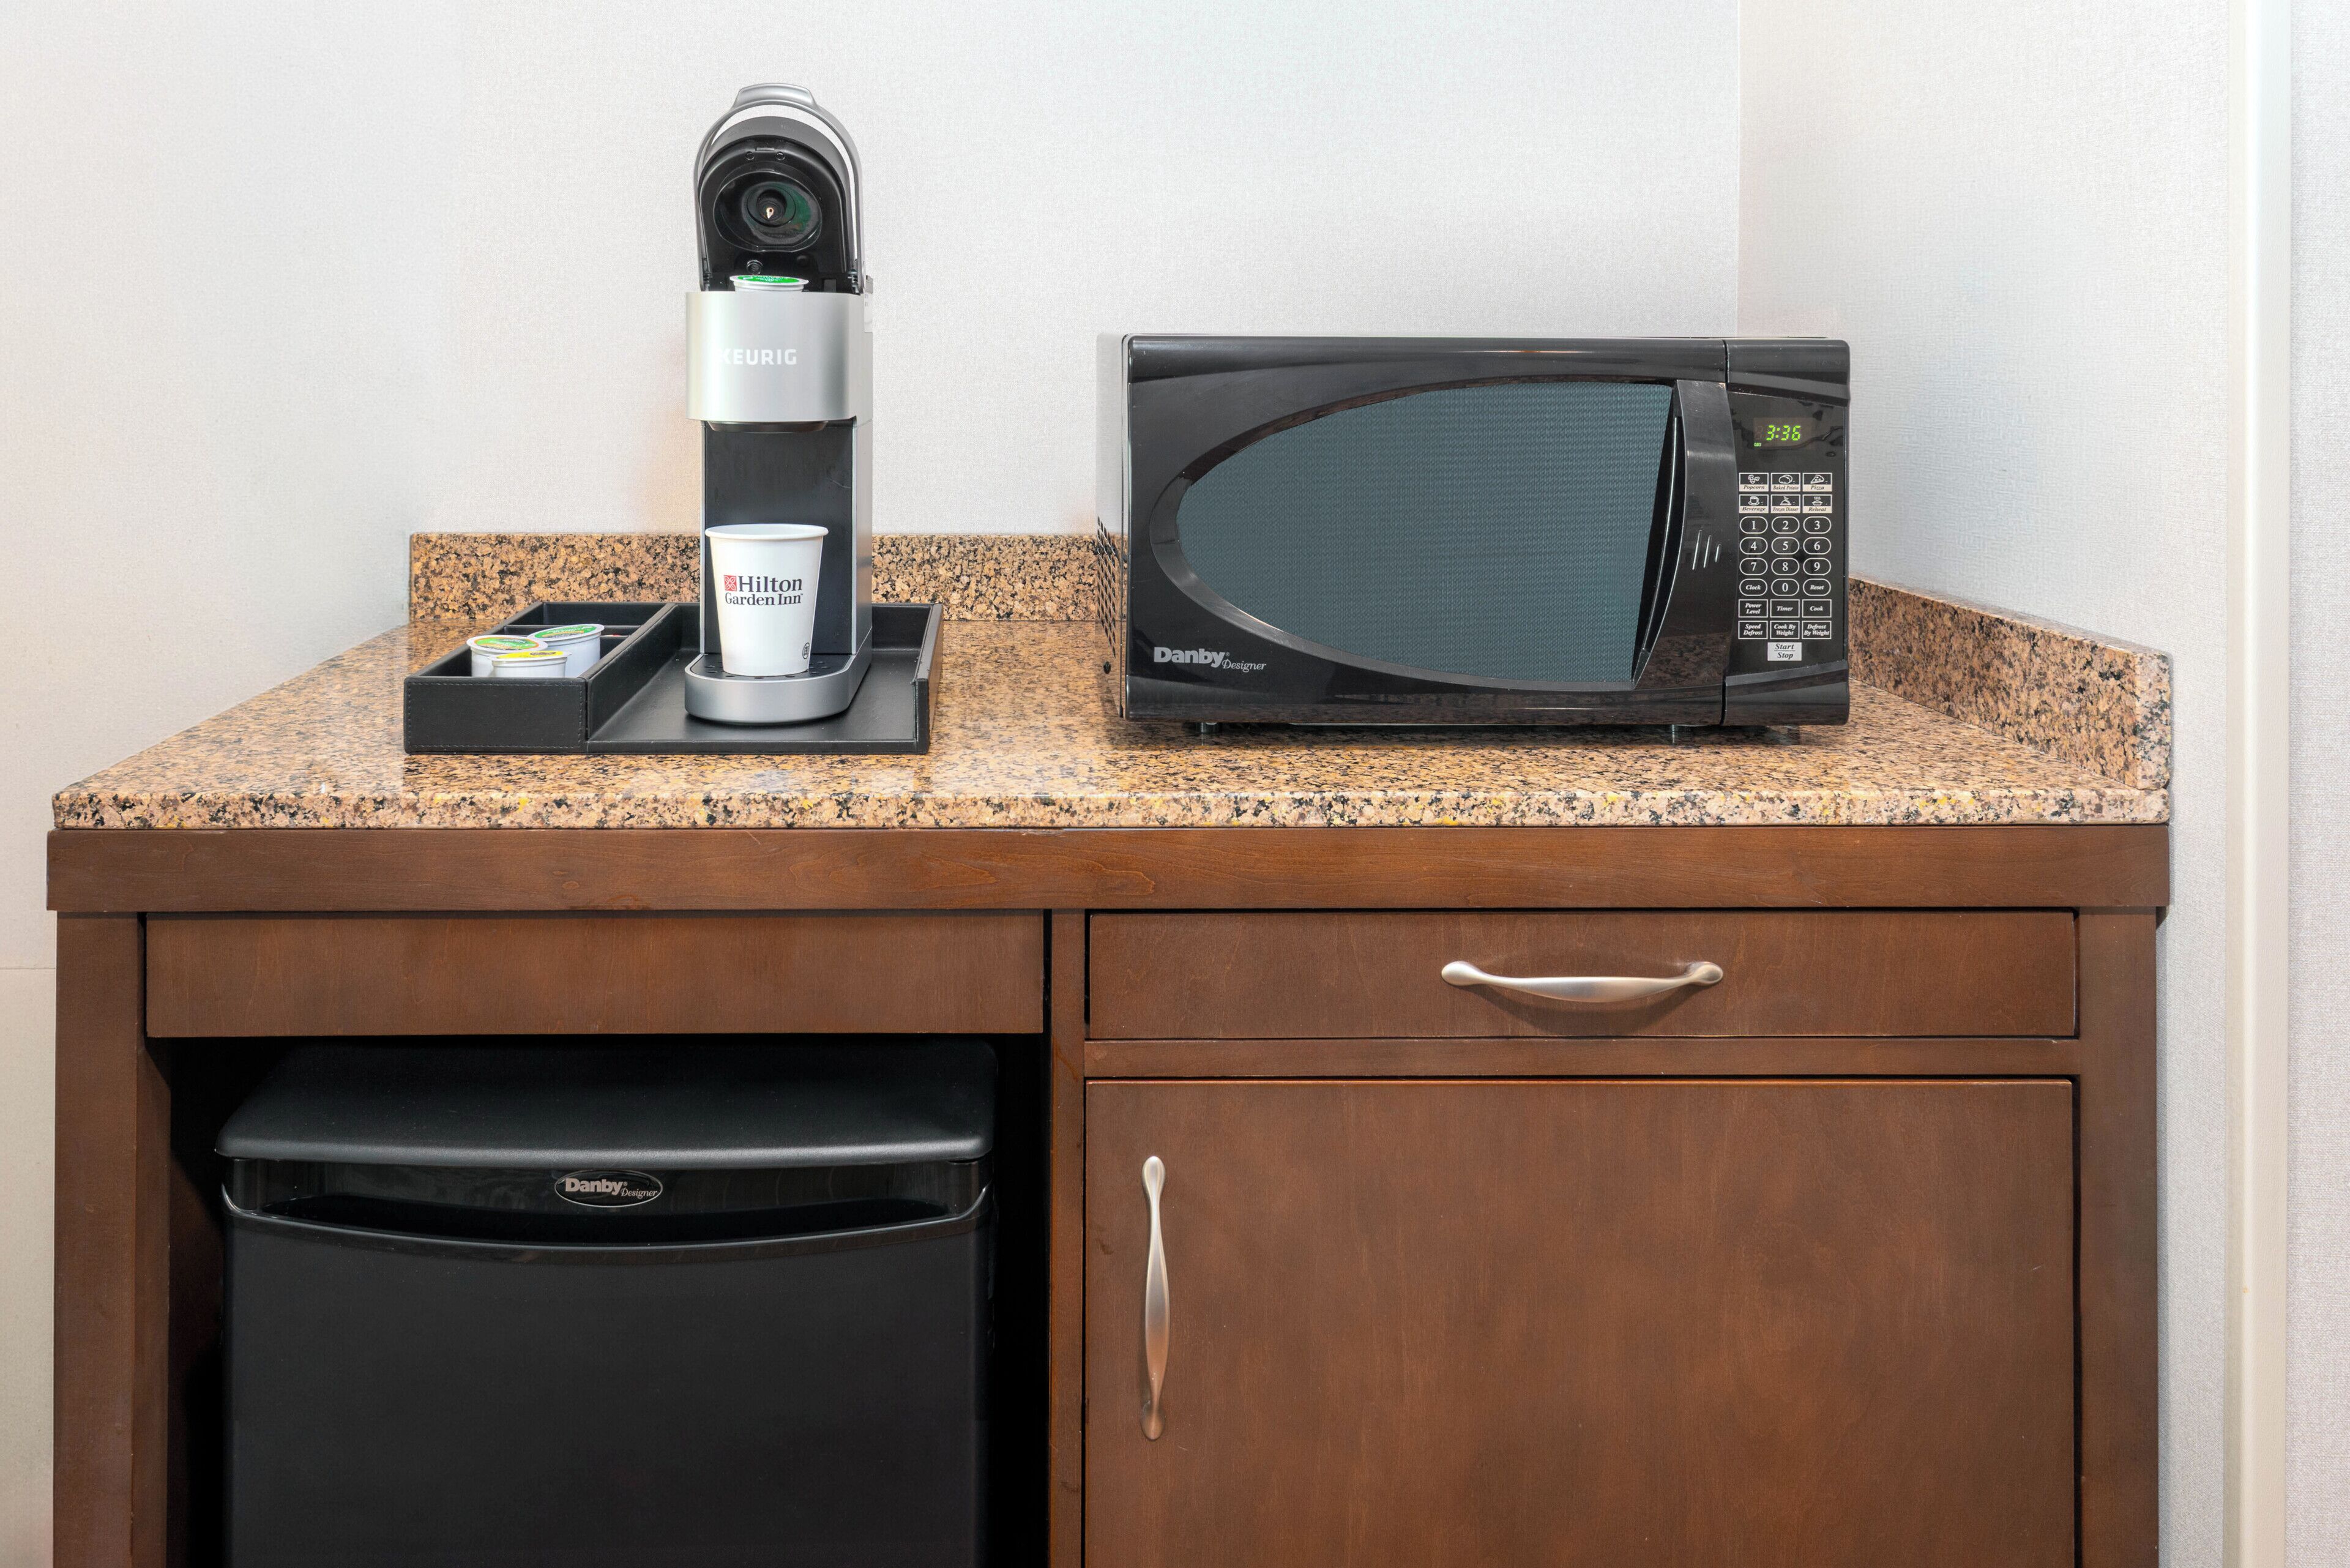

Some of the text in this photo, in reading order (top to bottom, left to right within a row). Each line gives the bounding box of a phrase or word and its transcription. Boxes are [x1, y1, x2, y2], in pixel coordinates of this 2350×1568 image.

[1766, 425, 1801, 441] 3:36
[1751, 520, 1756, 530] 1
[1782, 520, 1789, 530] 2
[1814, 520, 1821, 530] 3
[1750, 541, 1757, 551] 4
[1782, 541, 1789, 551] 5
[1813, 541, 1821, 551] 6
[1750, 562, 1757, 572] 7
[1782, 562, 1789, 572] 8
[1813, 562, 1821, 572] 9
[738, 576, 802, 592] Hilton
[1781, 582, 1789, 592] 0
[725, 592, 775, 605] Garden
[1222, 659, 1267, 673] Designer
[621, 1187, 658, 1199] Designer
